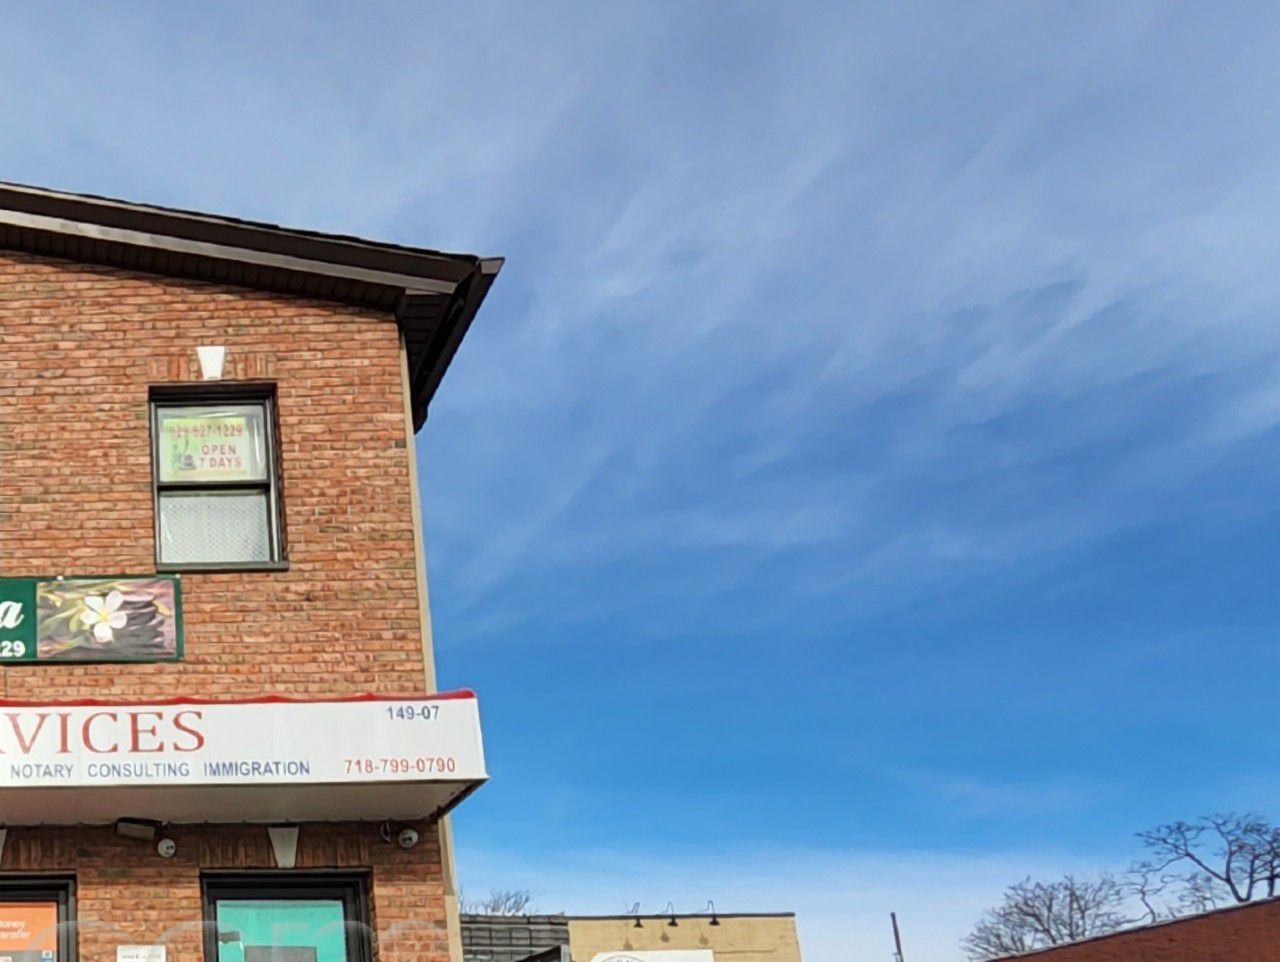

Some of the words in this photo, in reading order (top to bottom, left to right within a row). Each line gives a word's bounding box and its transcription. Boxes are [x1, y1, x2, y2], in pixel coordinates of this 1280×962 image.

[201, 444, 237, 456] OPEN
[209, 456, 242, 468] DAYS
[386, 704, 440, 721] 149-07
[10, 762, 74, 779] NOTARY
[87, 760, 190, 778] CONSULTING
[203, 758, 310, 777] IMMIGRATION
[343, 757, 456, 775] 718-799-0790
